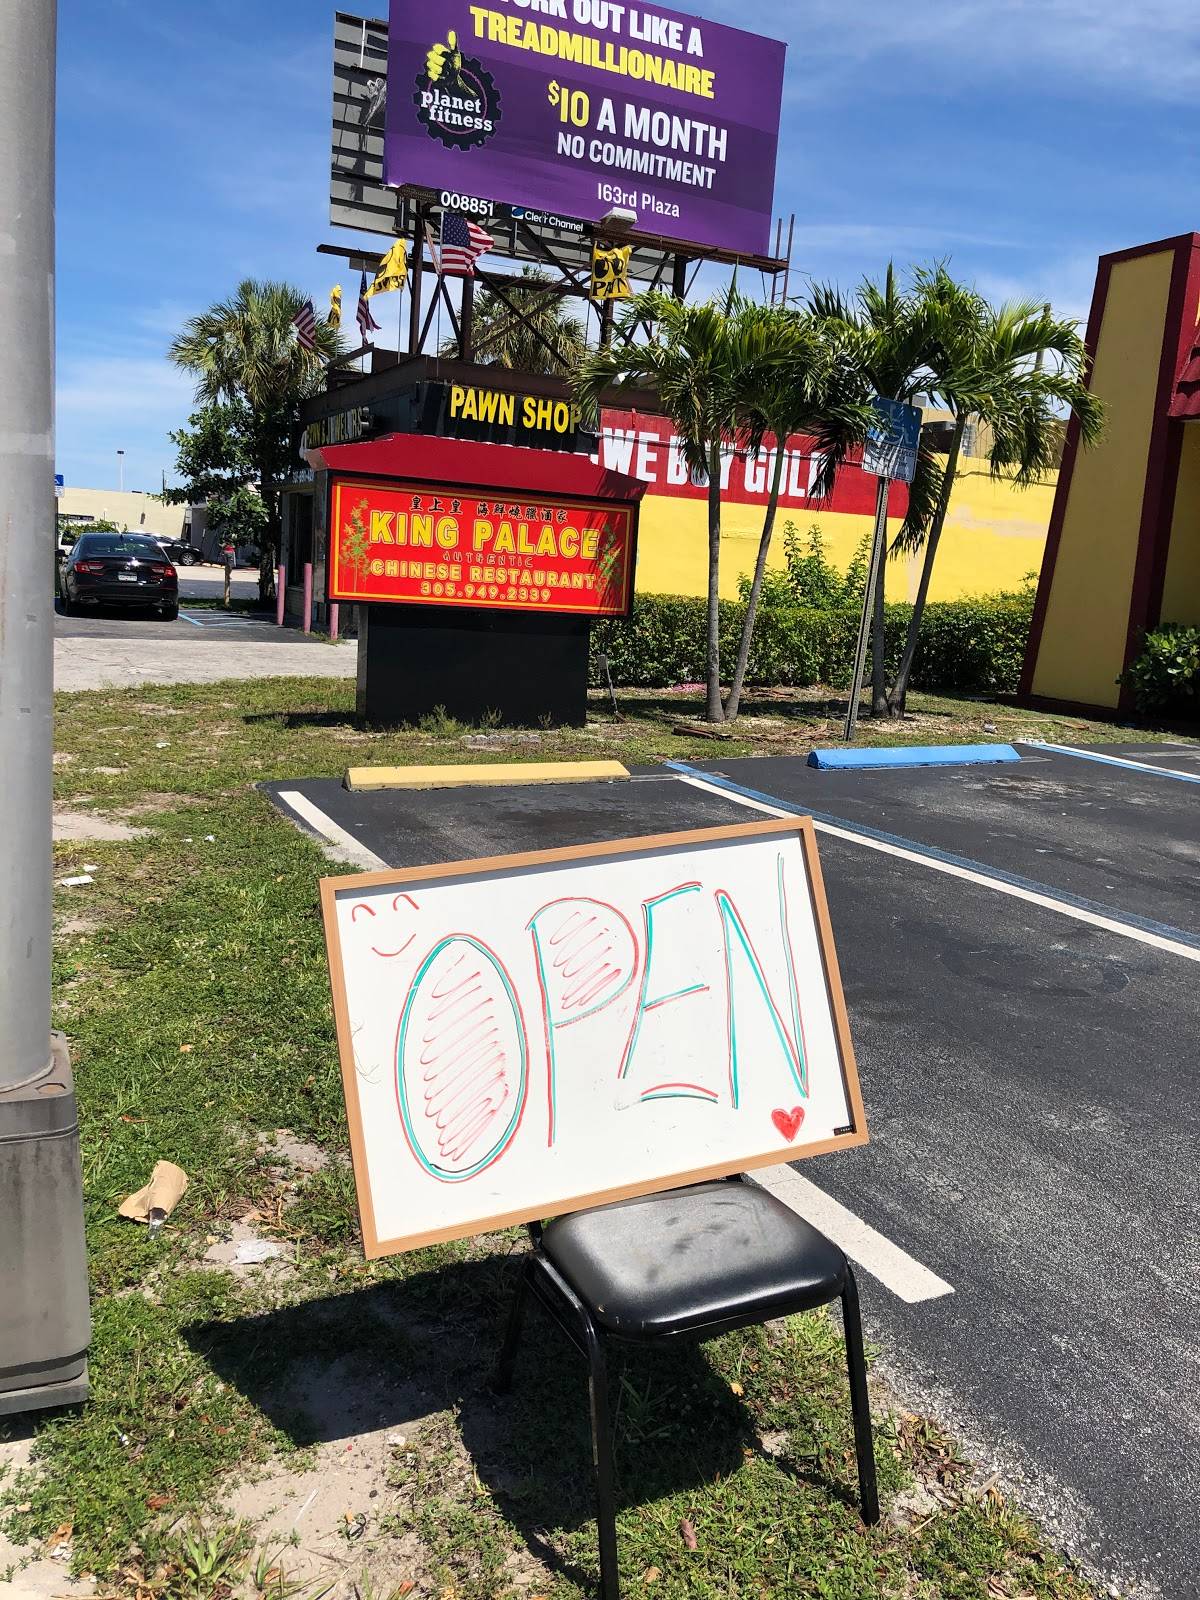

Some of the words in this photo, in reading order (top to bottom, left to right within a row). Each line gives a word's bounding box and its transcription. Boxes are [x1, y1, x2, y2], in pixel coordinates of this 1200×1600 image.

[573, 0, 625, 34] OUT
[629, 9, 684, 52] LIKE
[686, 26, 704, 57] A
[470, 5, 716, 99] TREADMILLIONAIRE
[420, 88, 482, 114] planet
[429, 104, 493, 132] fitness
[547, 79, 591, 127] $10
[596, 97, 617, 135] A
[624, 103, 728, 162] MONTH
[557, 131, 585, 160] NO
[589, 139, 716, 189] COMMITMENT
[440, 191, 494, 217] 008851
[597, 182, 638, 208] 163rd
[641, 193, 680, 218] Plaza
[548, 216, 584, 232] Channel
[450, 385, 515, 426] PAWN
[522, 397, 582, 434] SHOP
[602, 427, 660, 483] WE
[744, 445, 827, 498] GOLD
[410, 496, 463, 515] 皇上皇
[369, 510, 459, 549] KING
[472, 519, 600, 560] PALACE
[370, 559, 462, 581] CHINESE
[470, 566, 597, 589] RESTAURANT
[443, 551, 534, 568] AUTHENTIC
[420, 581, 552, 602] 305.949.2339
[394, 852, 809, 1183] OPEN
